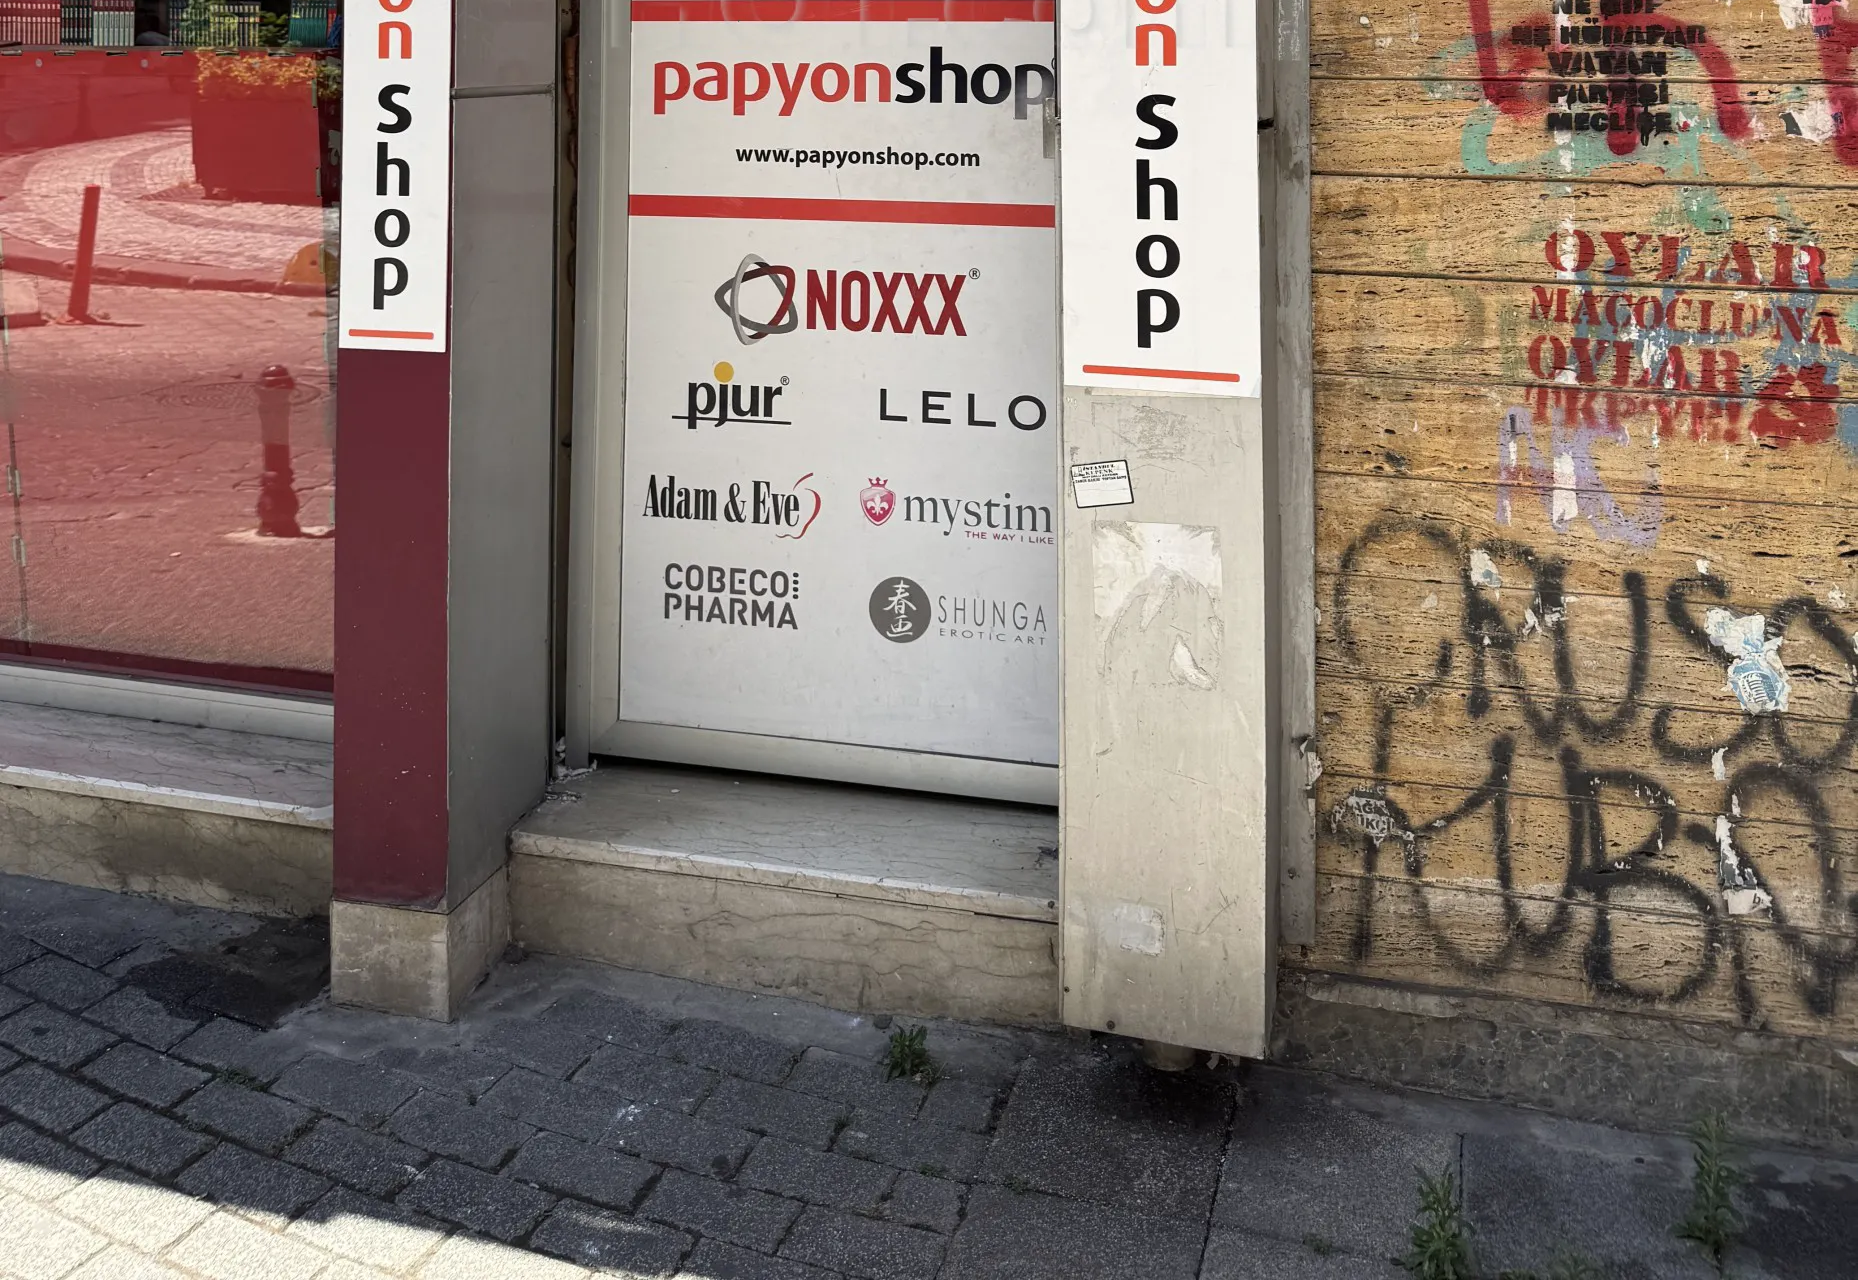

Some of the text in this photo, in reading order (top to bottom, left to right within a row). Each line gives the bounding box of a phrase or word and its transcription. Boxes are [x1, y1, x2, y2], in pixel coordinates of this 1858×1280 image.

[653, 46, 1055, 120] papyonshop
[735, 146, 981, 169] www.papyonshop.com
[373, 84, 412, 310] shop
[1135, 94, 1180, 348] shop
[1545, 230, 1831, 289] OYLAR
[806, 269, 967, 337] NOXXX
[1527, 334, 1742, 394] OYLAR
[687, 362, 782, 429] pjur
[880, 387, 1047, 431] LELO
[642, 474, 799, 527] Adam & Eve
[904, 492, 1053, 536] mystim
[965, 531, 987, 539] THE
[993, 533, 1016, 541] WAY
[1029, 536, 1054, 545] LIKE
[665, 562, 789, 598] COBECO
[664, 593, 798, 630] PHARMA
[938, 595, 1047, 632] SHUNGA
[940, 628, 1047, 646] EROTIC ART
